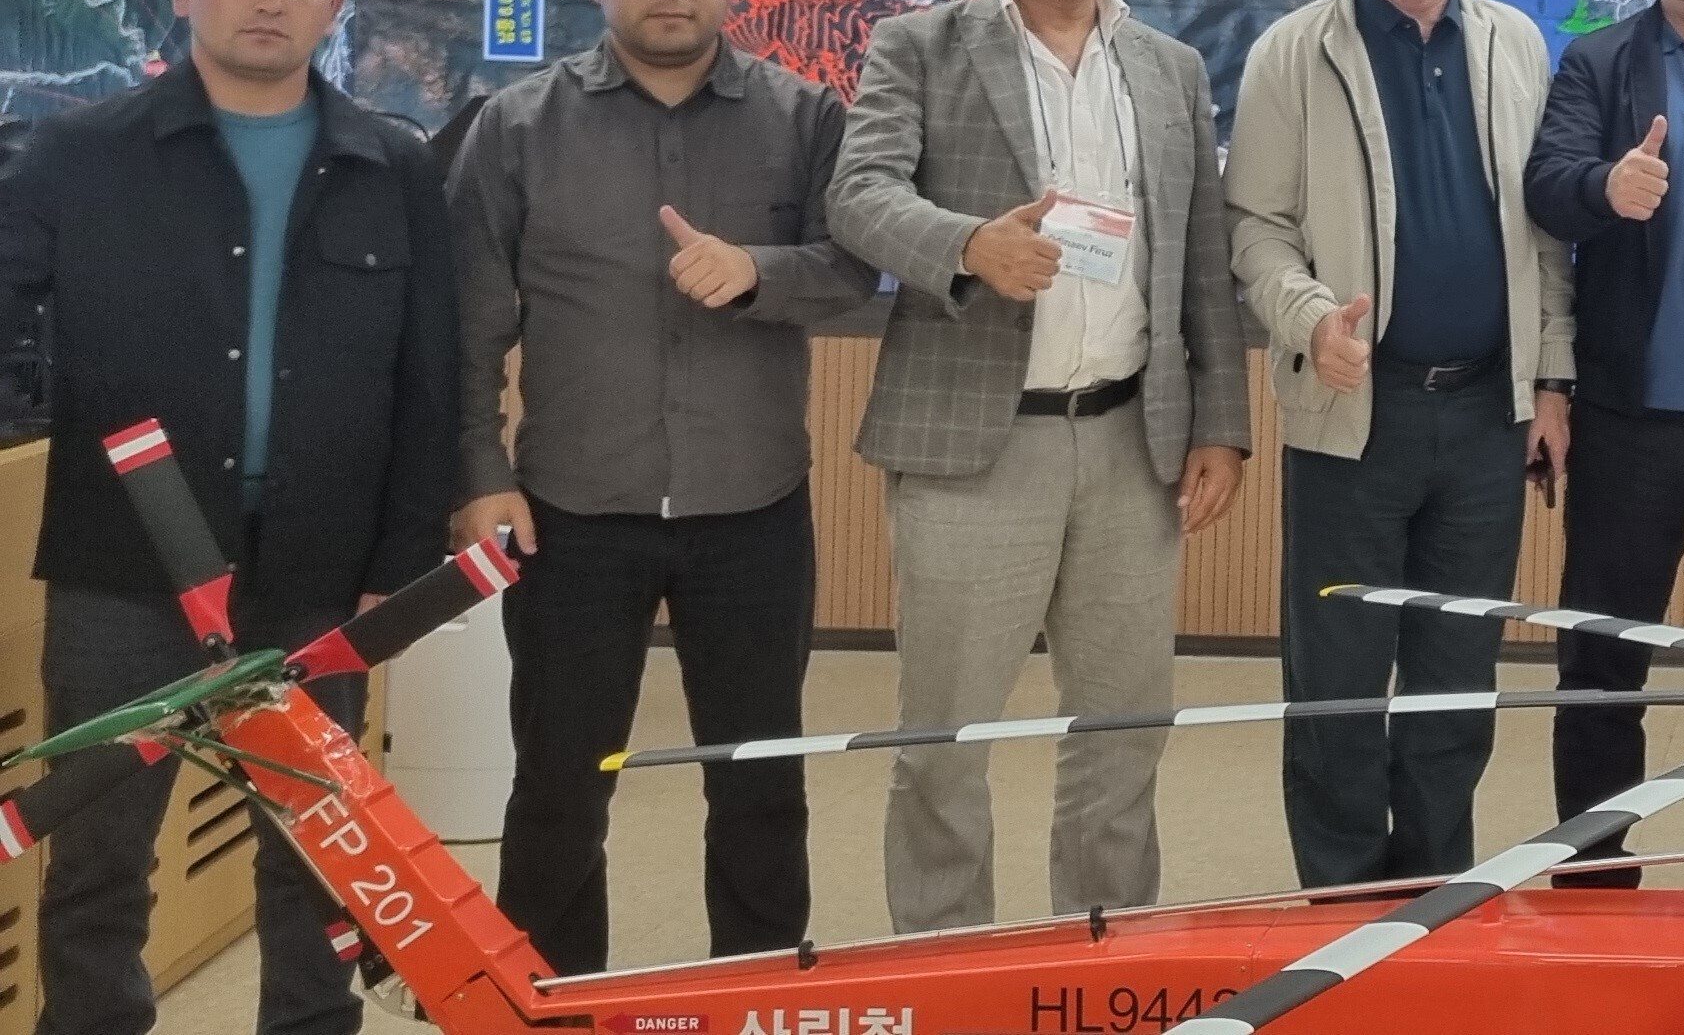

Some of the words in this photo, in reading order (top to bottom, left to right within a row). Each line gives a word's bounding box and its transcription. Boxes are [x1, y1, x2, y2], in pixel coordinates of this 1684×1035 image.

[300, 792, 369, 857] FP
[350, 864, 435, 951] 201
[635, 1017, 700, 1031] DANGER
[1031, 986, 1241, 1034] HL944
